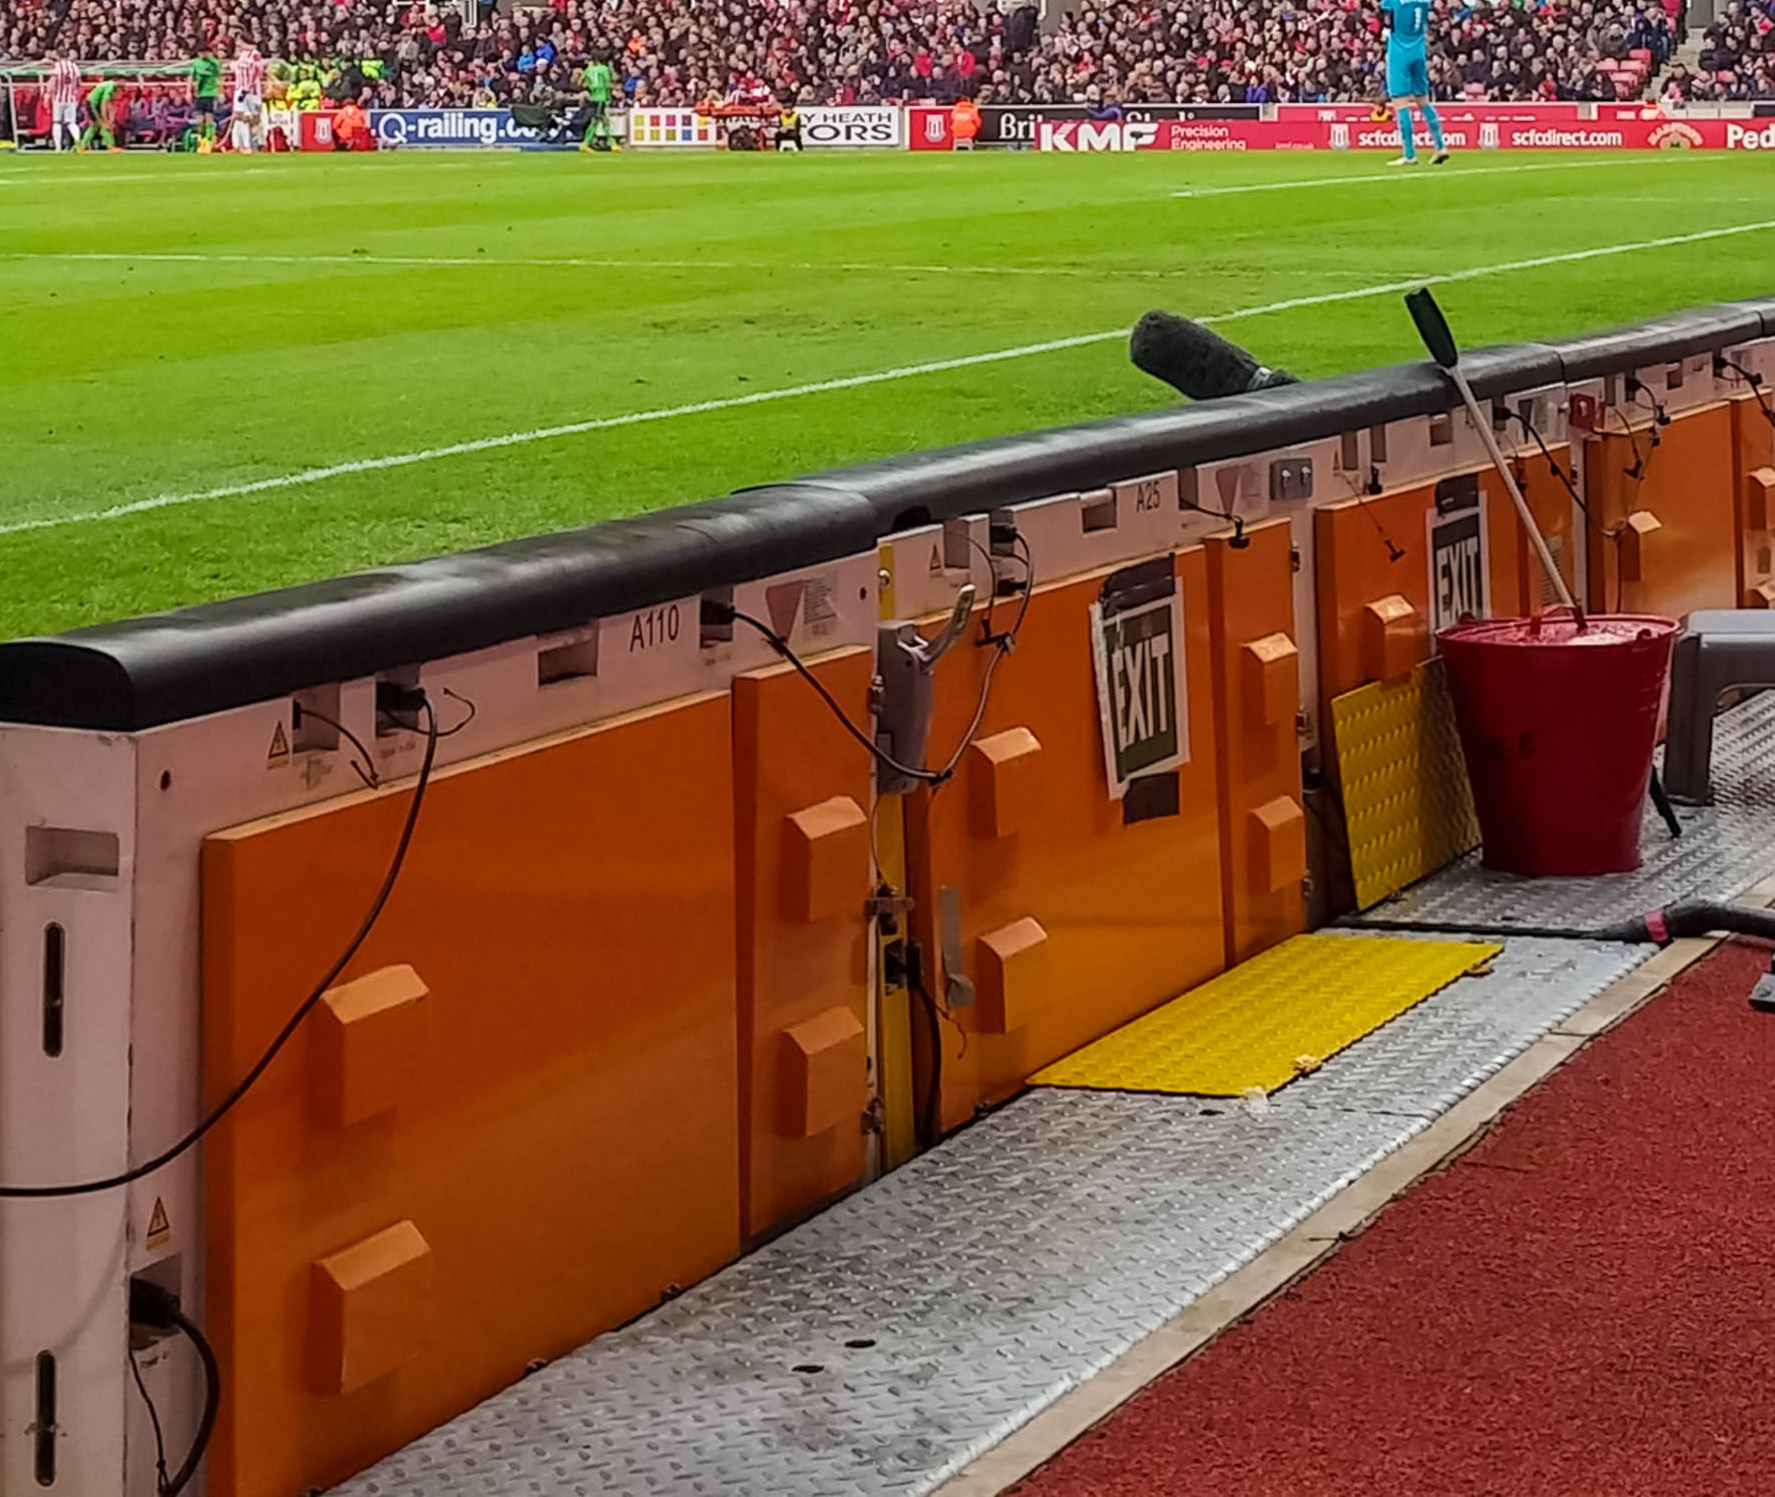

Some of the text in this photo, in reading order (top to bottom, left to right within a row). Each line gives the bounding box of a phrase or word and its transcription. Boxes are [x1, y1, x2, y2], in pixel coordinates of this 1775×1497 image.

[823, 113, 893, 124] HEATH
[801, 125, 893, 142] ORS
[1037, 122, 1159, 152] KMF
[1171, 124, 1229, 138] Precision
[1512, 131, 1622, 147] scfcdirect.com
[1171, 137, 1246, 151] Engineering
[1136, 478, 1163, 513] A25
[1436, 535, 1479, 630] EXIT
[629, 604, 681, 653] A110
[1111, 632, 1170, 753] EXIT
